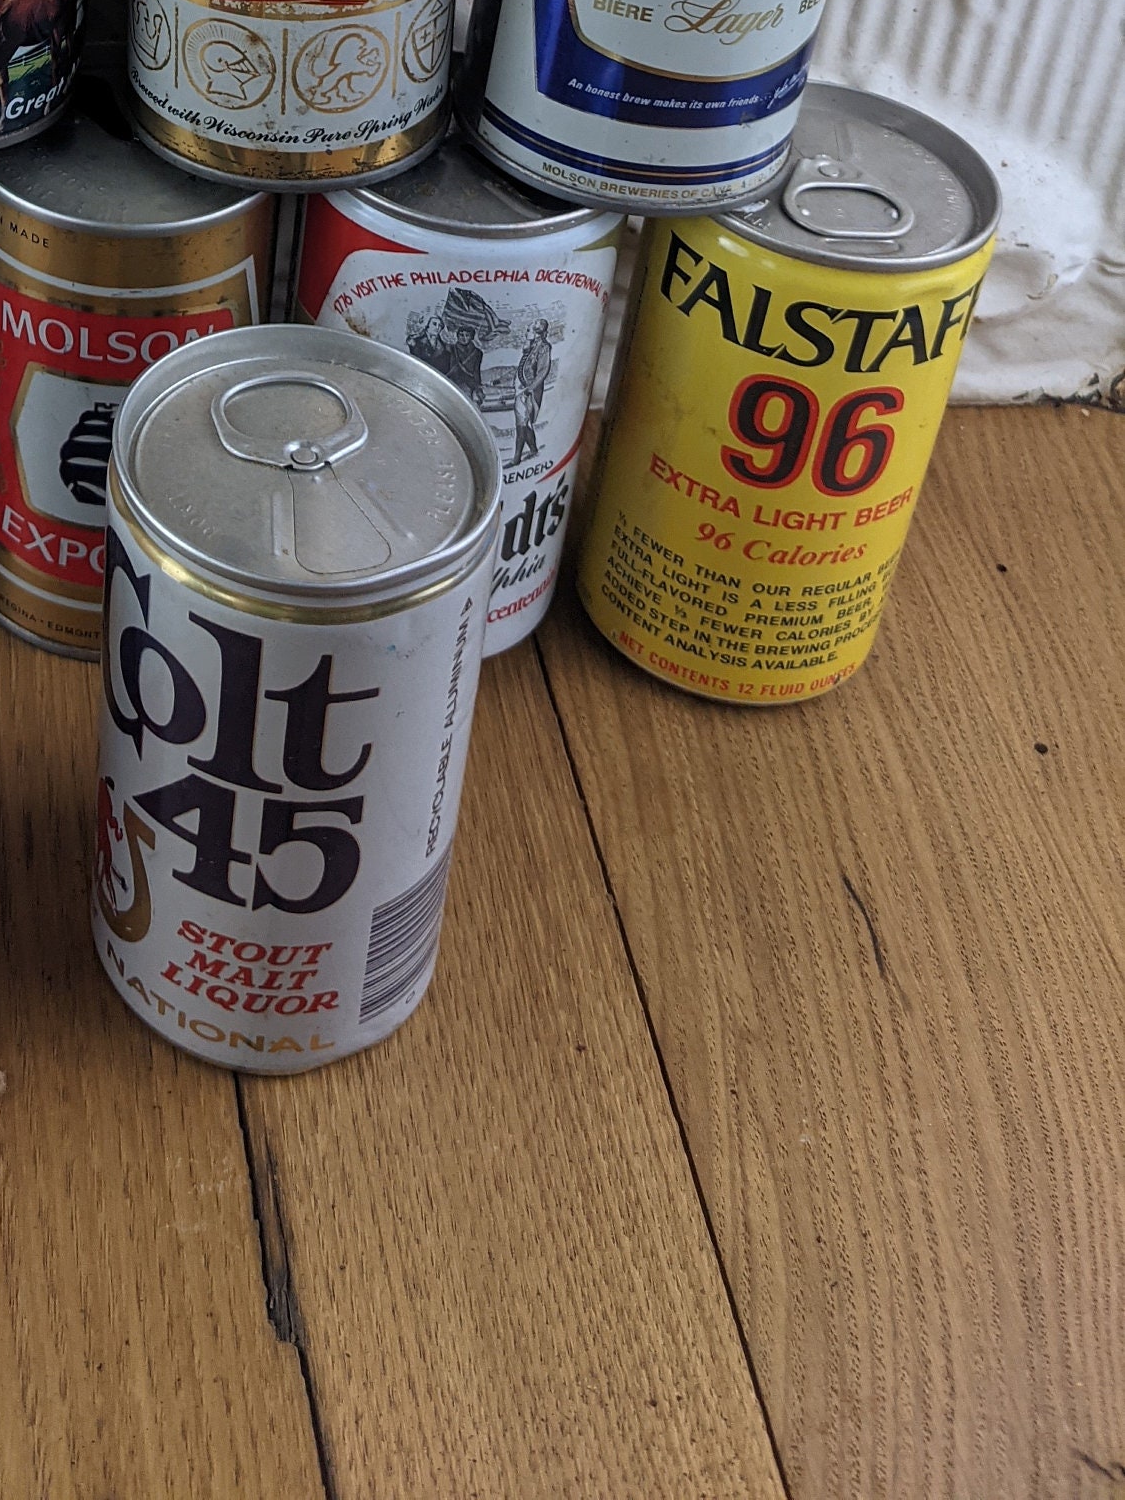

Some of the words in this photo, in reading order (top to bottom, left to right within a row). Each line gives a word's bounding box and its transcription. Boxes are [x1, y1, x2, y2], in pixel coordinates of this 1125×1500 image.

[5, 76, 65, 120] Great
[131, 65, 166, 109] Brewed
[168, 104, 202, 127] with
[204, 115, 299, 144] Wisconsin
[302, 129, 352, 145] Pure
[354, 111, 412, 139] Spring
[568, 78, 583, 90] An
[585, 83, 620, 101] honest
[622, 93, 651, 106] brew
[653, 99, 686, 110] makes
[689, 100, 703, 110] its
[705, 100, 726, 109] own
[542, 162, 597, 190] MOLSON
[599, 182, 678, 200] BREWERIES
[681, 189, 699, 198] OF
[10, 222, 50, 248] MADE
[334, 291, 353, 315] 1776
[351, 279, 378, 298] VISIT
[378, 273, 407, 289] THE
[409, 269, 530, 284] PHILADELPHIA
[535, 269, 602, 298] BICENTENNIAL
[720, 373, 905, 497] 96
[650, 452, 741, 518] EXTRA
[753, 505, 846, 531] LIGHT
[853, 486, 914, 527] BEER
[614, 525, 653, 564] EXTRA
[662, 561, 711, 594] LIGHT
[722, 591, 739, 604] IS
[749, 599, 762, 609] A
[774, 600, 818, 611] LESS
[828, 582, 877, 609] FILLING
[633, 526, 685, 568] FEWER
[695, 564, 742, 588] THAN
[752, 583, 791, 596] OUR
[801, 572, 872, 596] REGULAR
[695, 522, 734, 550] 96
[742, 539, 867, 567] Calories
[604, 569, 645, 611] ADDED
[649, 605, 690, 634] STEP
[694, 629, 711, 643] IN
[717, 636, 749, 653] THE
[755, 640, 830, 655] BREWING
[607, 555, 662, 605] ACHIEVE
[700, 616, 763, 639] FEWER
[776, 619, 851, 641] CALORIES
[611, 540, 728, 617] FULL-FLAVORED
[744, 613, 823, 627] PREMIUM
[103, 525, 380, 794] Colt
[602, 584, 660, 637] CONTENT
[664, 634, 748, 667] ANALYSIS
[649, 651, 729, 691] CONTENTS
[737, 683, 754, 695] 12
[760, 682, 804, 696] FLUID
[133, 773, 365, 914] 45
[177, 920, 333, 966] STOUT
[185, 950, 318, 990] MALT
[107, 940, 335, 1052] NATIONAL
[160, 961, 339, 1015] LIQUOR
